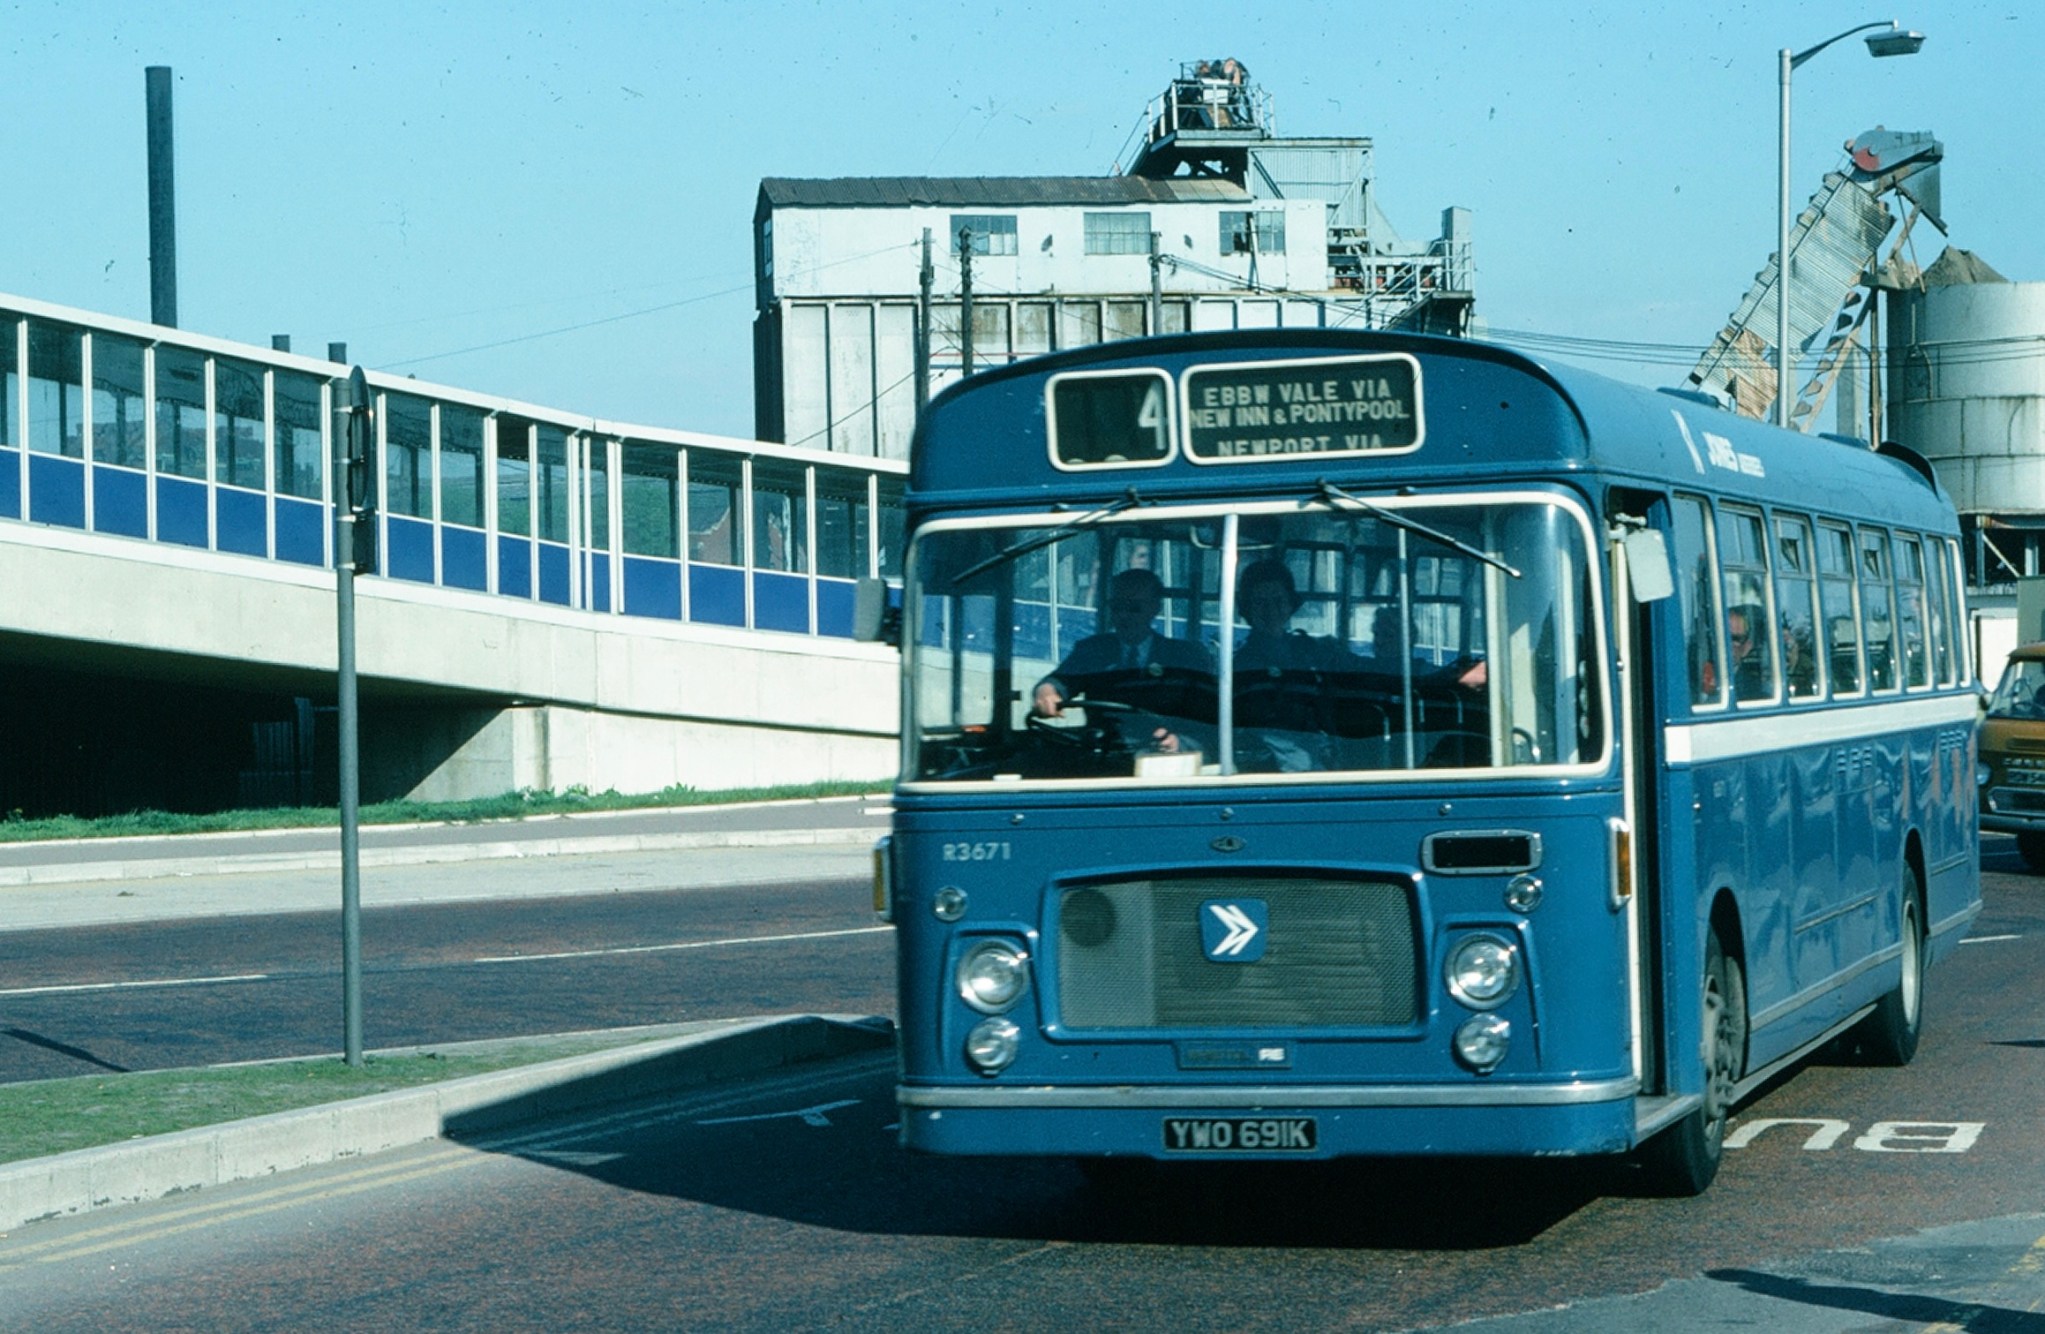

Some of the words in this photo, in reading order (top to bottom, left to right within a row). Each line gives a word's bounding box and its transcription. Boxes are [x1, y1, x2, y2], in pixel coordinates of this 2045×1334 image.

[1204, 384, 1270, 407] EBBW
[1278, 380, 1338, 403] VALE
[1352, 378, 1391, 400] VIA
[1138, 381, 1166, 450] 4
[1189, 408, 1231, 428] NEW
[1236, 406, 1269, 426] INN
[1273, 408, 1287, 425] &
[1290, 400, 1410, 424] PONTYPOOL
[943, 842, 1011, 861] R3671
[1171, 1121, 1232, 1148] YWO
[1239, 1121, 1310, 1147] 691K
